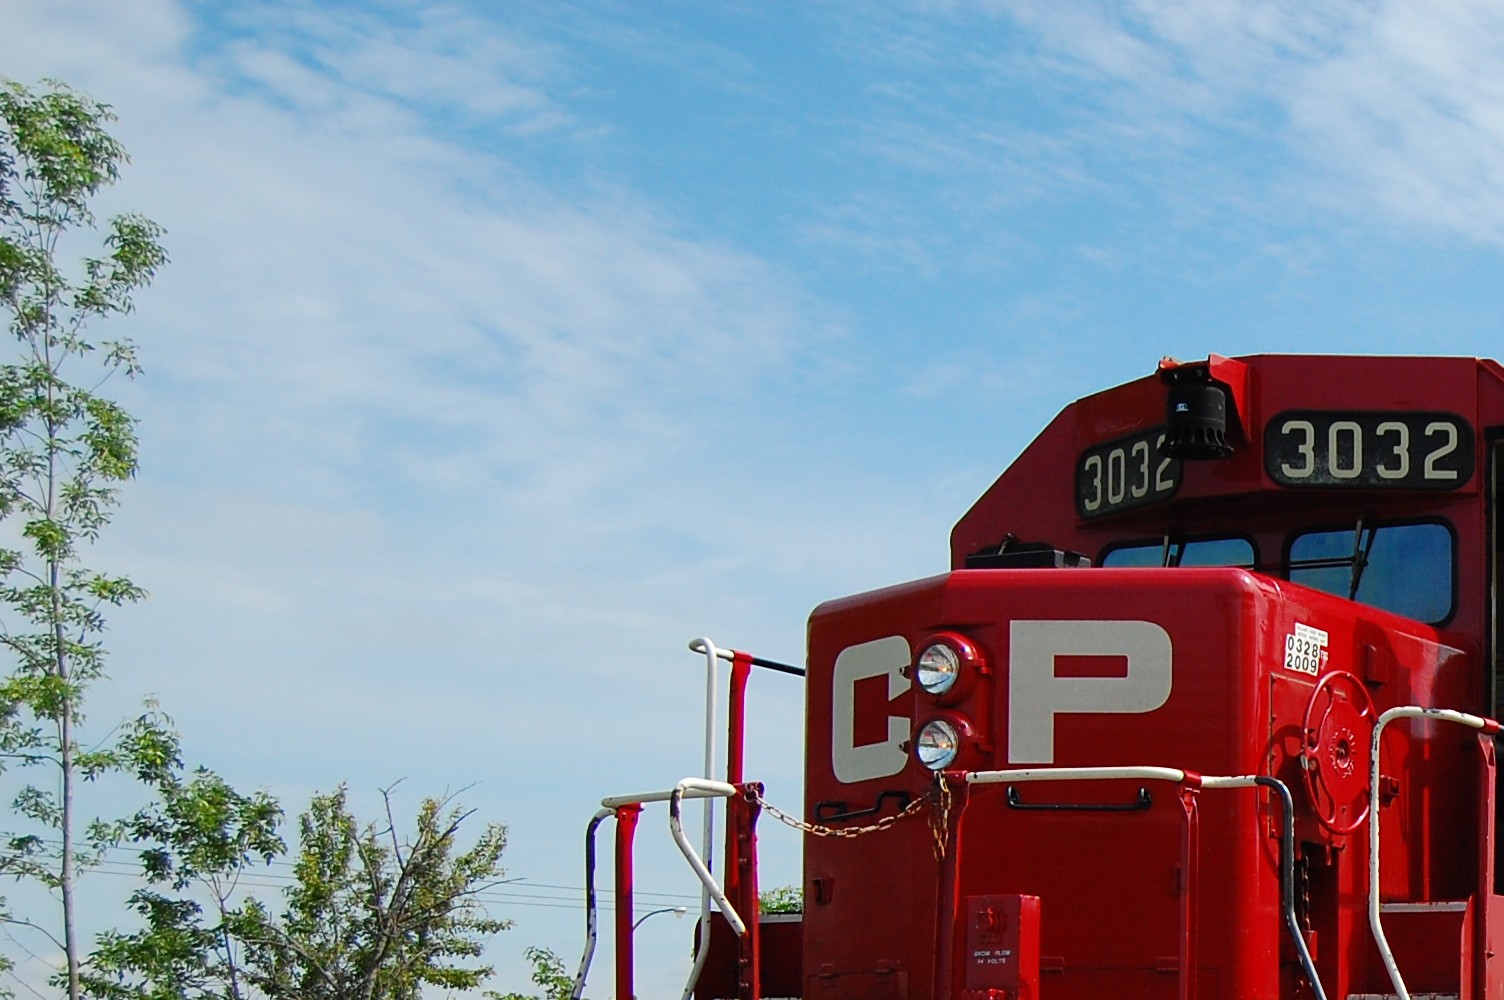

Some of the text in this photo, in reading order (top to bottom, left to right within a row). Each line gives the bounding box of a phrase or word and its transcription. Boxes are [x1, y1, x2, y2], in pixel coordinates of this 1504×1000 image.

[1084, 433, 1174, 511] 3032
[1281, 420, 1458, 479] 3032
[1286, 652, 1317, 673] 2009
[1287, 636, 1319, 658] 0328
[832, 619, 1173, 784] CP
